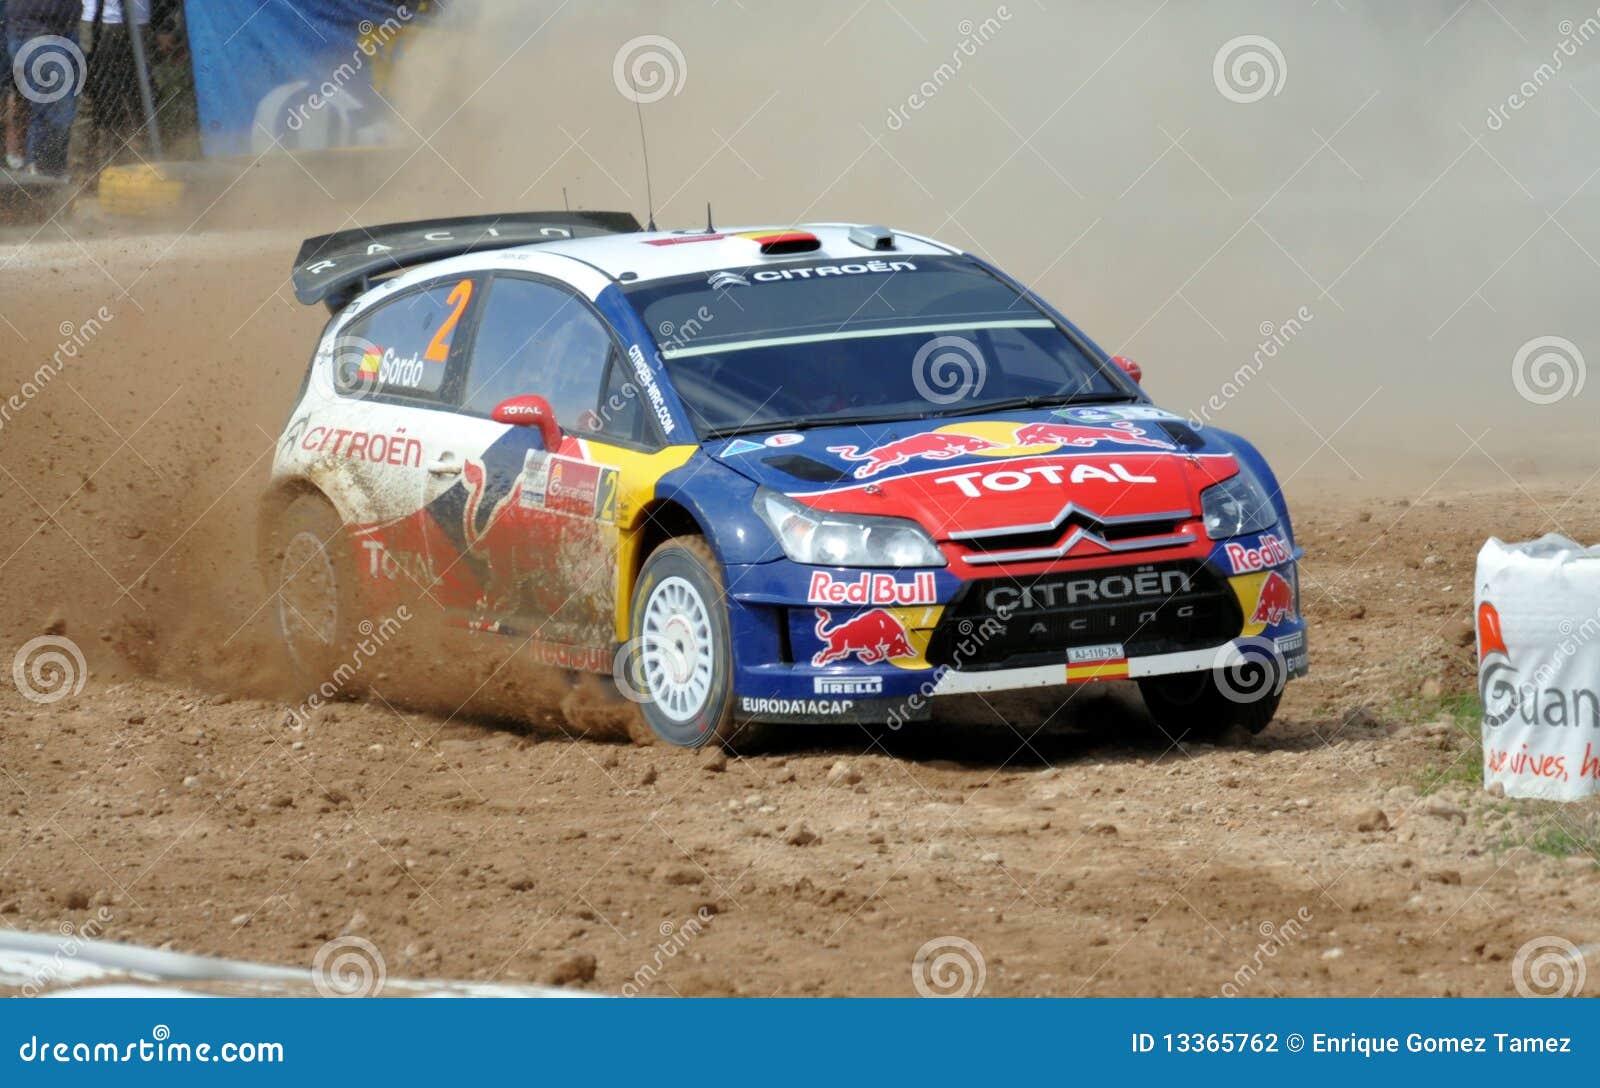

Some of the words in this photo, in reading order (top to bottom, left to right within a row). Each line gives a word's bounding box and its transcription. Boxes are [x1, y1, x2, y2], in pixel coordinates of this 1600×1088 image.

[424, 278, 473, 362] 2
[378, 347, 424, 388] Sordo
[502, 405, 542, 415] TOTAL
[601, 470, 617, 520] 2
[934, 463, 1157, 498] TOTAL
[814, 676, 883, 694] PIRELLI
[1510, 743, 1569, 782] vives,
[1580, 742, 1600, 780] h
